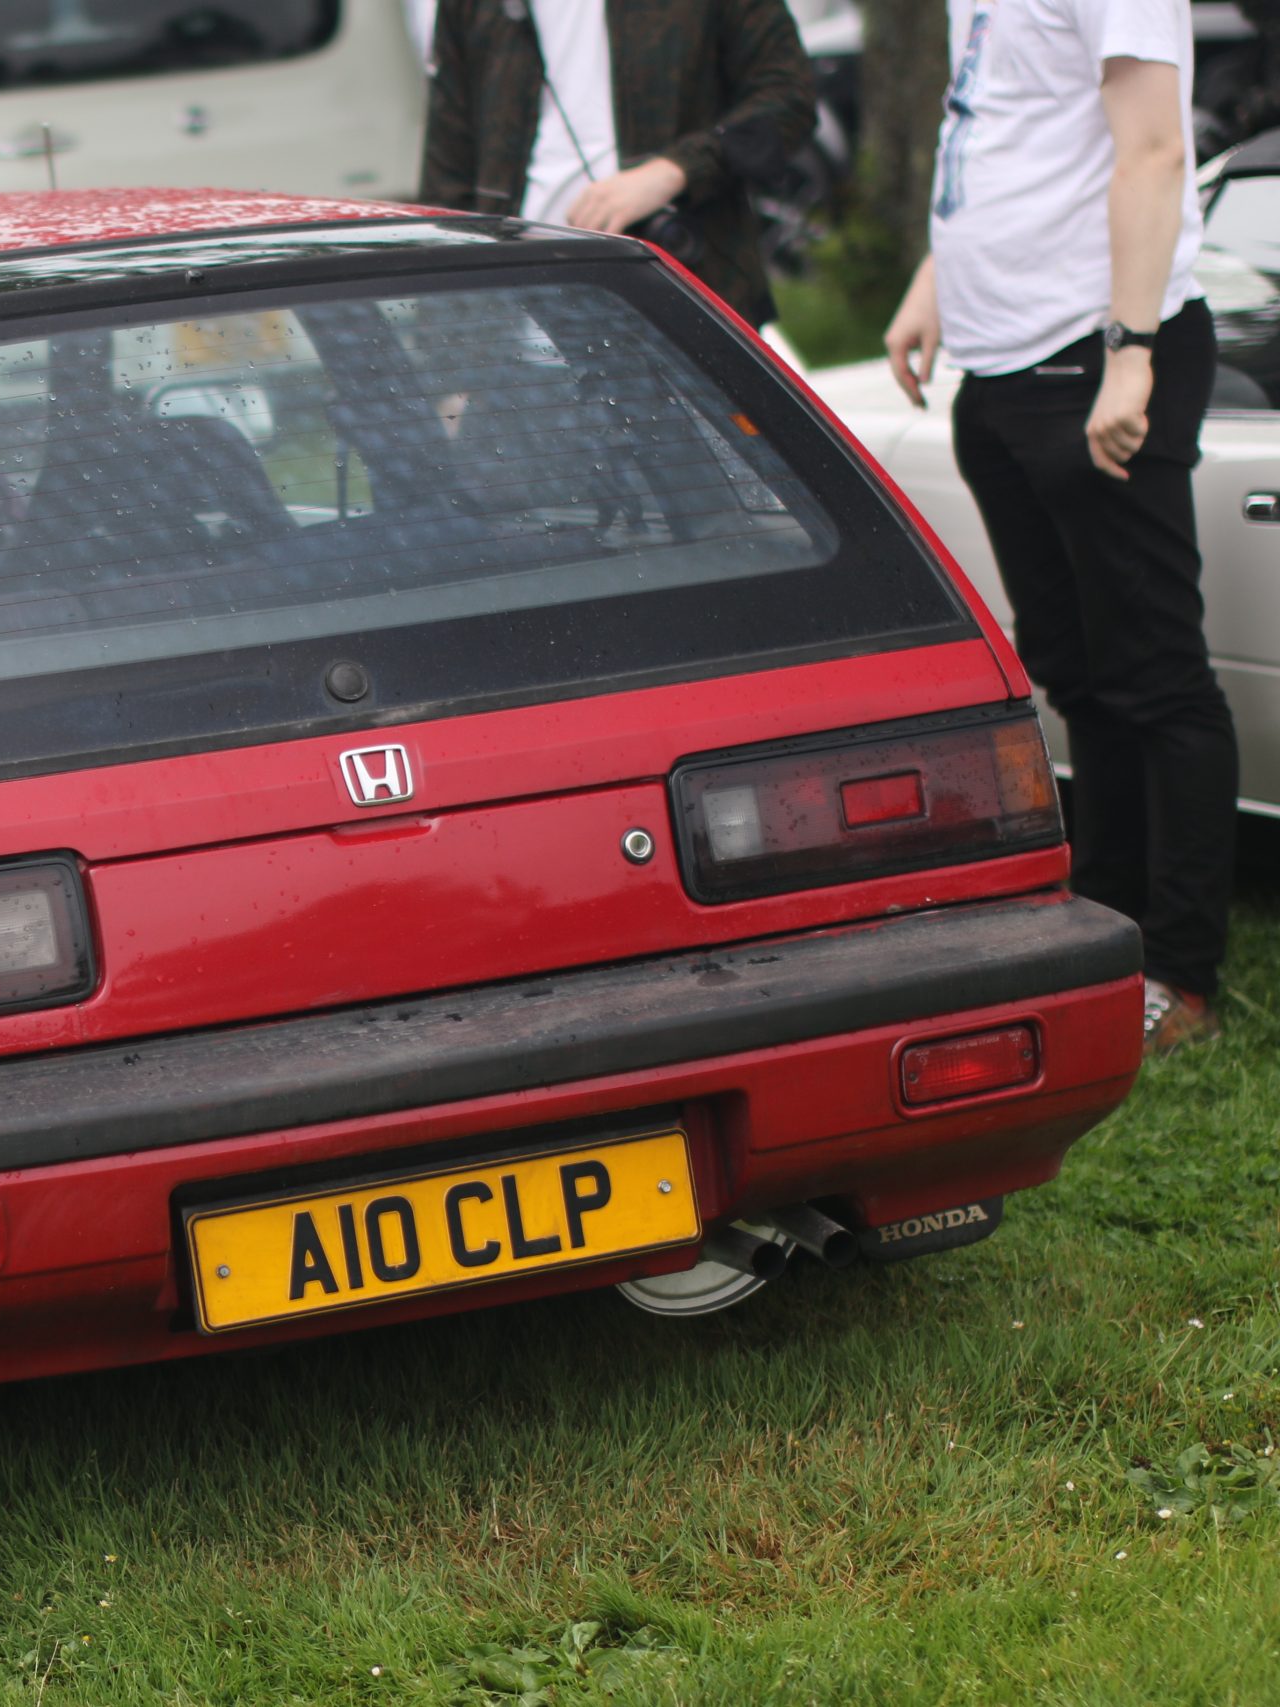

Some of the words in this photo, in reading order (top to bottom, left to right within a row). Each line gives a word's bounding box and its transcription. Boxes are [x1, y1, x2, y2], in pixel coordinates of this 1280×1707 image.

[288, 1195, 421, 1301] A10
[444, 1159, 612, 1268] CLP
[878, 1204, 989, 1244] HONDA
